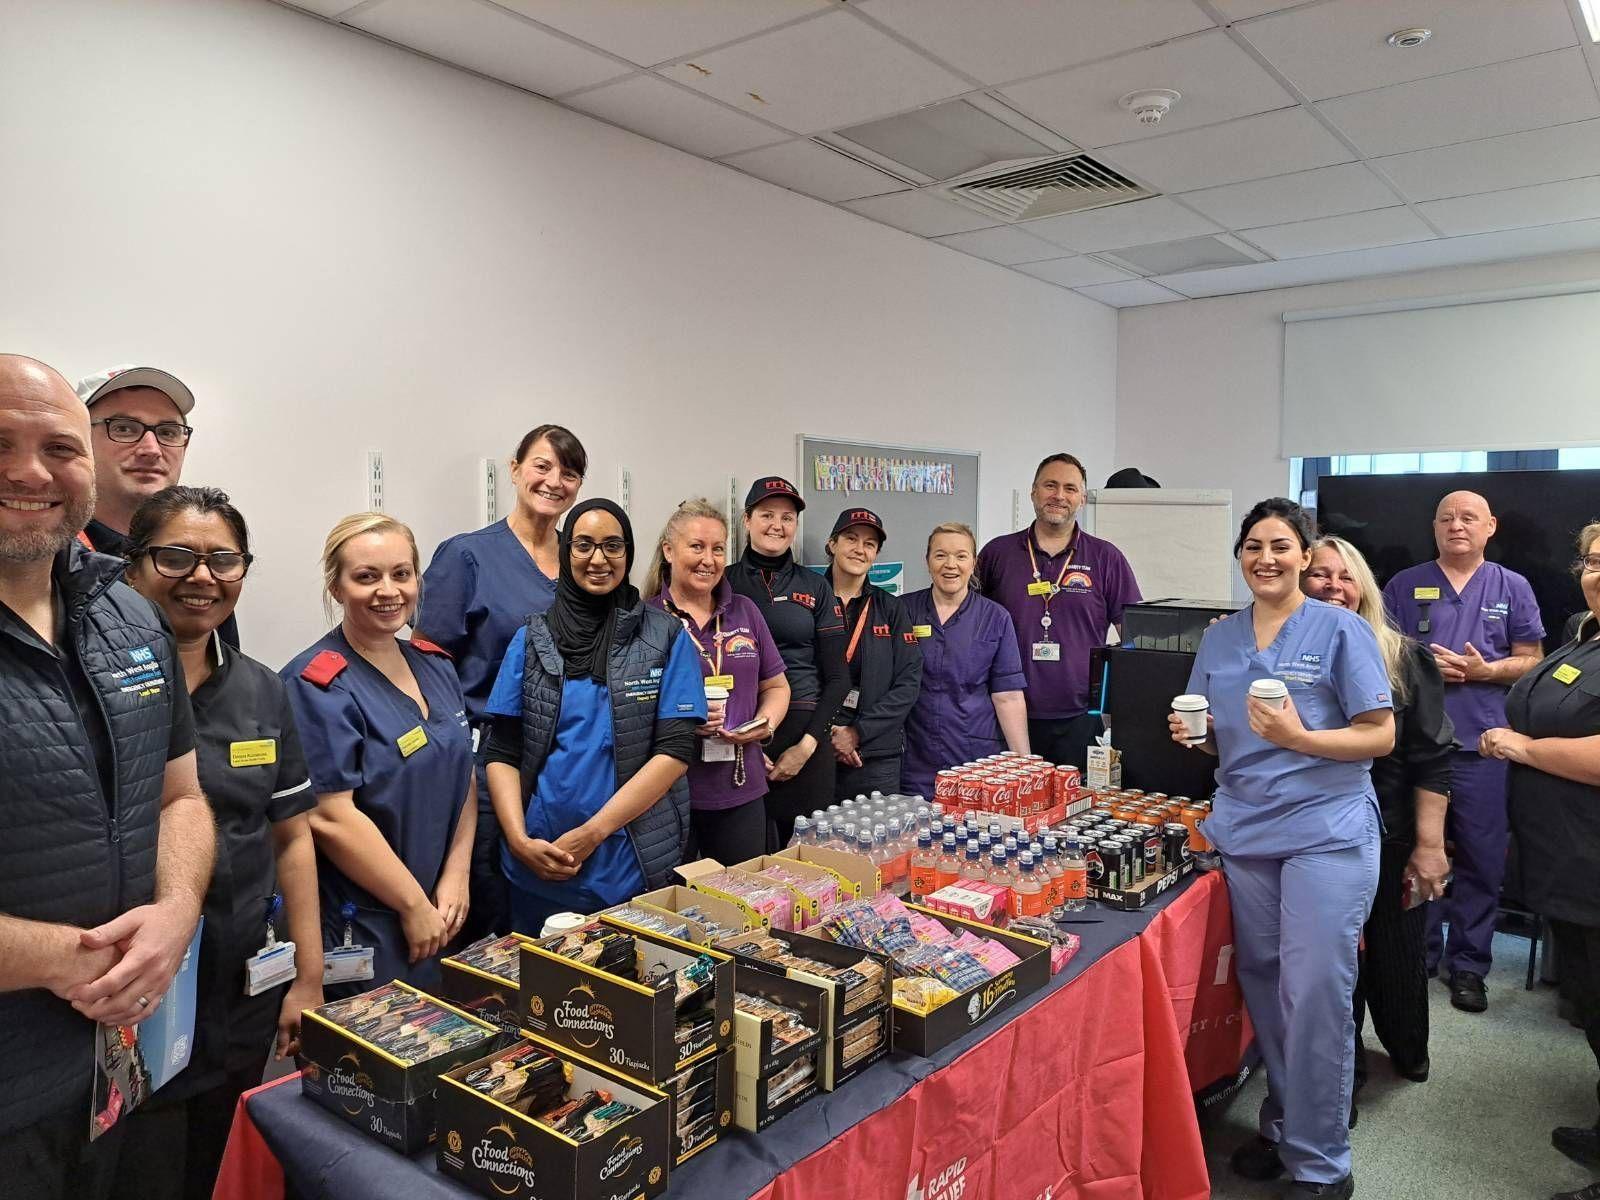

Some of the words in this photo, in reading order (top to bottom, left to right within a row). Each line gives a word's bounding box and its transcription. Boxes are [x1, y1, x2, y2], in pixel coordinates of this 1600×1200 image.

[130, 646, 153, 663] NHS
[1302, 654, 1320, 663] NHS
[1156, 869, 1179, 894] PEPSI
[1102, 891, 1124, 902] MAX
[983, 983, 994, 1010] 16
[562, 1000, 590, 1018] Food
[554, 1008, 615, 1039] Connections
[609, 1047, 625, 1065] 30
[625, 1056, 650, 1071] Flapjacks
[679, 1041, 693, 1060] 30
[334, 1067, 355, 1085] Food
[327, 1074, 375, 1107] Connections
[370, 1115, 383, 1133] 30
[481, 1139, 509, 1161] Food
[606, 1147, 626, 1167] Food
[472, 1147, 535, 1188] Connections
[600, 1143, 643, 1181] Connections
[928, 1156, 968, 1200] RAPID
